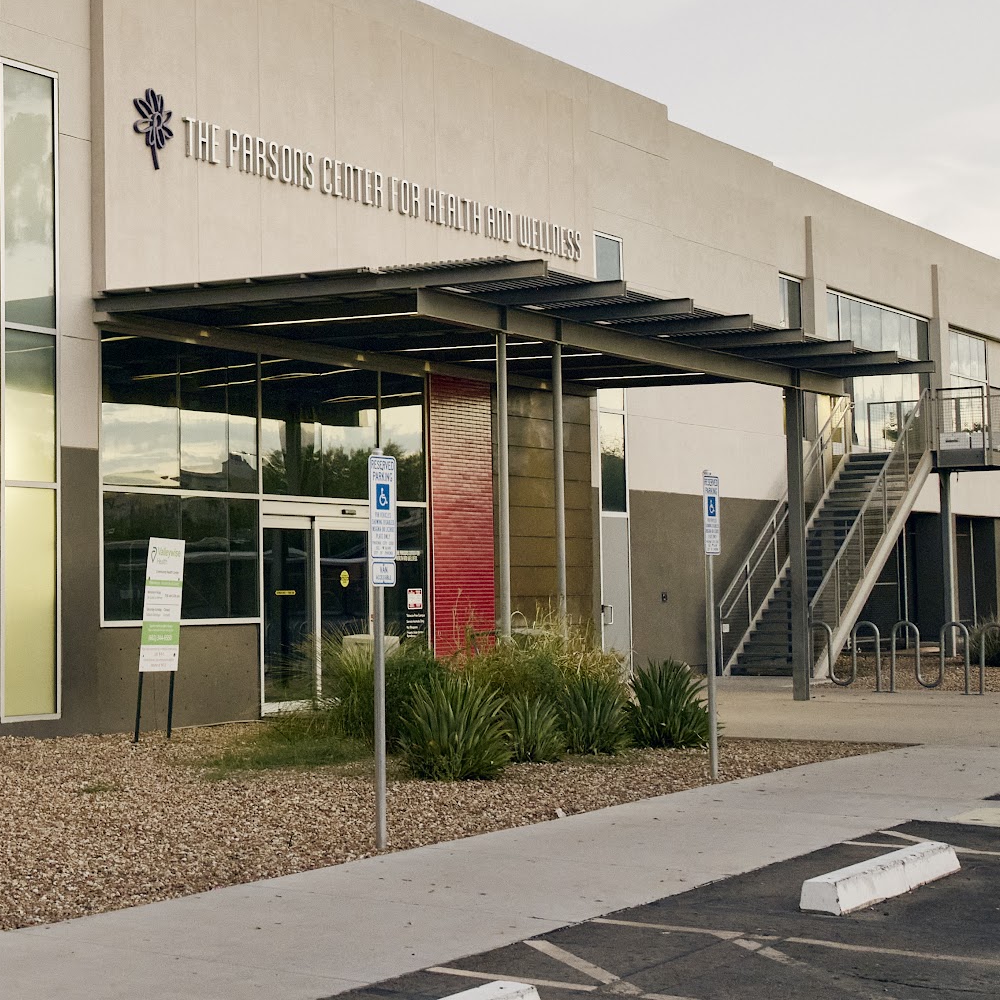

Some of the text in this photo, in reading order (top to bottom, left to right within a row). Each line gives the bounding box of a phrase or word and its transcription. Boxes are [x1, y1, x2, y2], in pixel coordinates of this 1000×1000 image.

[182, 117, 582, 262] THE PARSONS CENTER FOR HEALTH AND WELLNESS
[371, 460, 393, 470] RESERVED
[372, 471, 393, 482] PARKING
[158, 546, 181, 558] Valleywise
